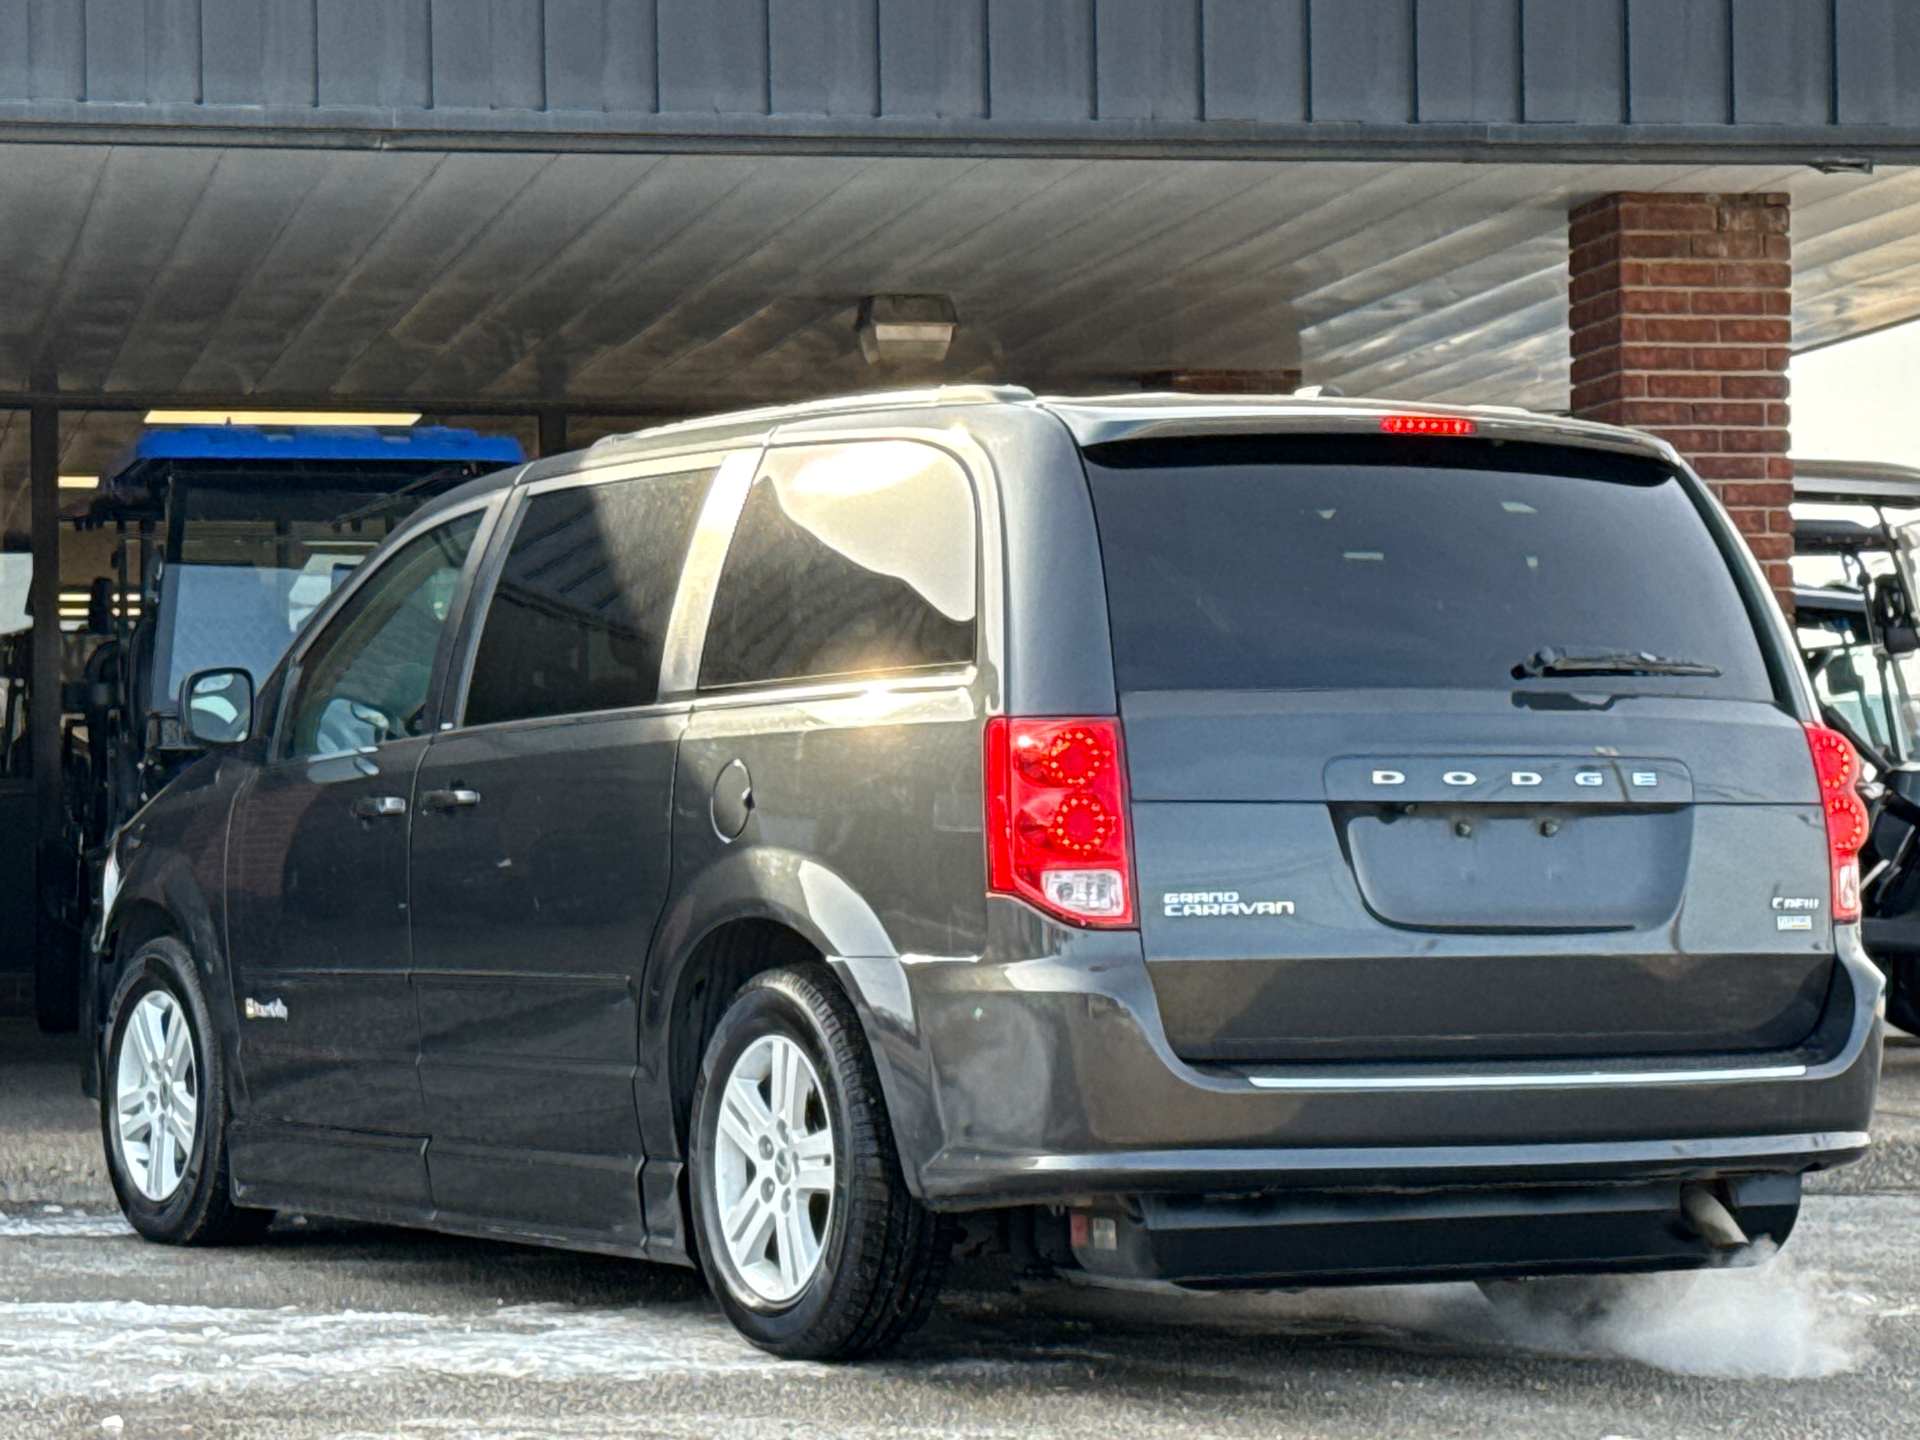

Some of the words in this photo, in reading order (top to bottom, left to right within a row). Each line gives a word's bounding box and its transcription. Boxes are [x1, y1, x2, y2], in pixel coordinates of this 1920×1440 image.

[1372, 770, 1658, 786] DODGE
[1164, 891, 1239, 904] GRAND
[1164, 901, 1295, 917] CARAVAN
